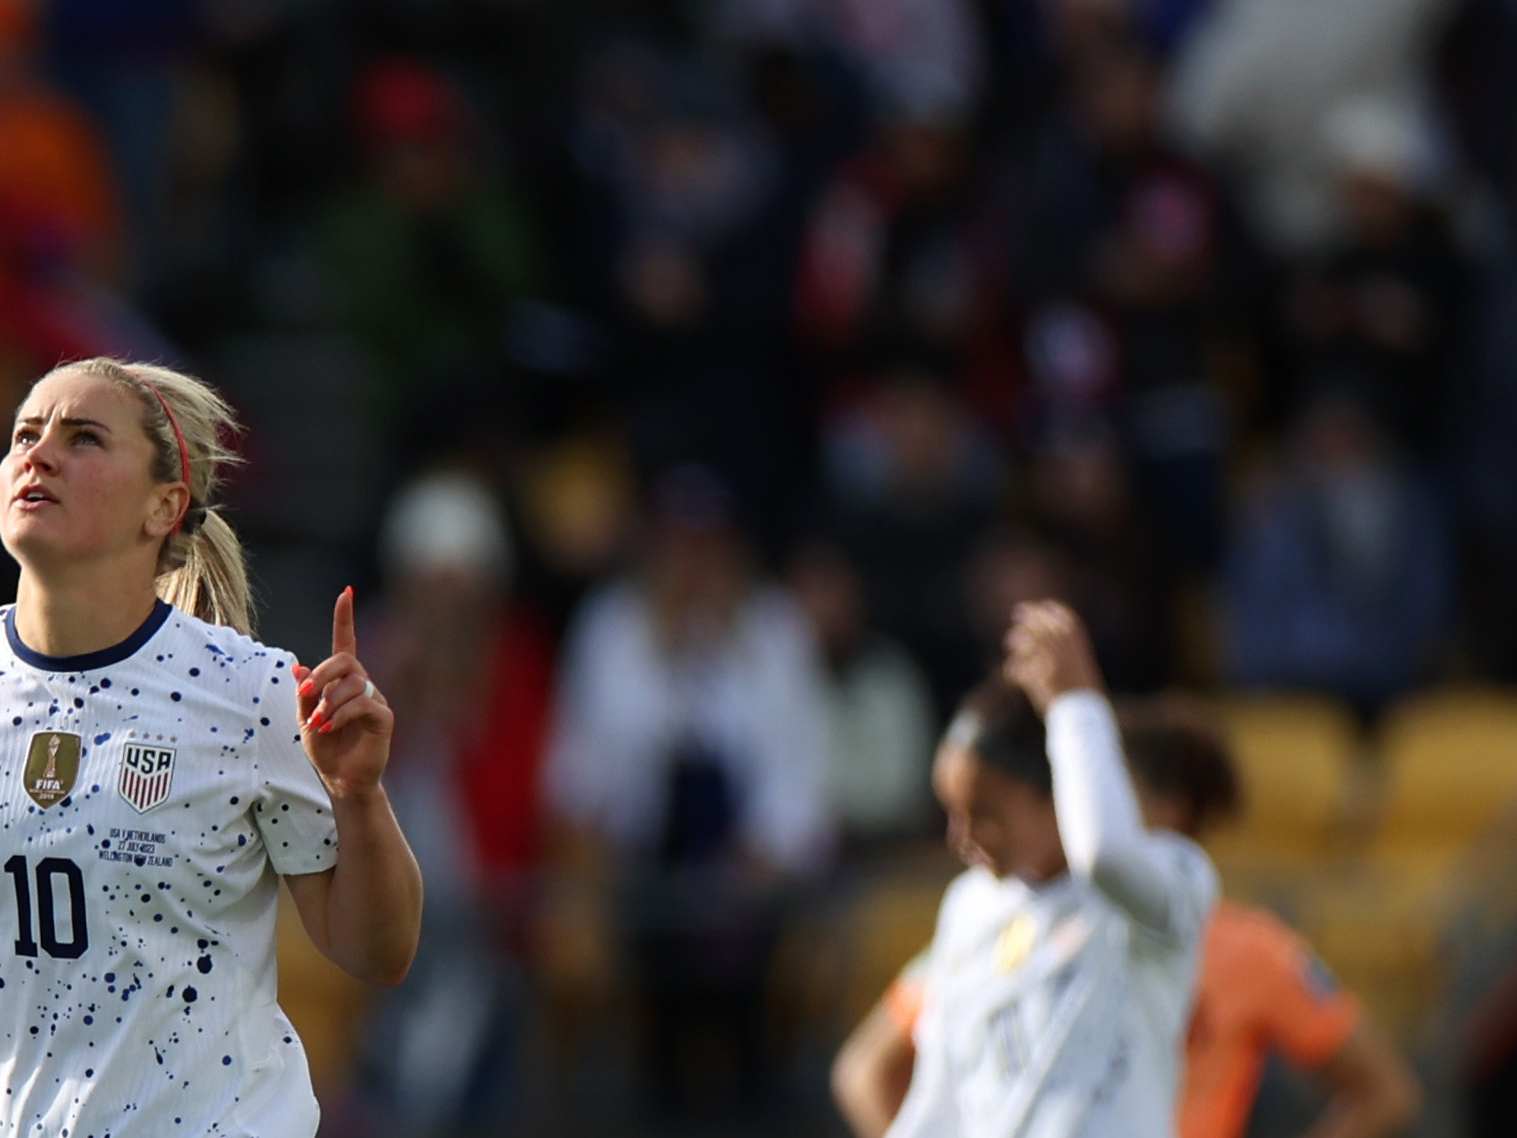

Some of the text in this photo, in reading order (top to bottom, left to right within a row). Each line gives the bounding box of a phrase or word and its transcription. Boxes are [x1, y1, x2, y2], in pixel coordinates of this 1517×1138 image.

[126, 748, 171, 775] USA
[35, 779, 60, 790] FIFA
[110, 828, 121, 838] USA
[128, 830, 166, 844] NETHERLANDS
[118, 840, 127, 851] 27
[127, 841, 141, 852] JULY
[99, 850, 133, 863] WELLINGTON
[147, 855, 173, 867] ZEALAND
[4, 855, 89, 959] 10
